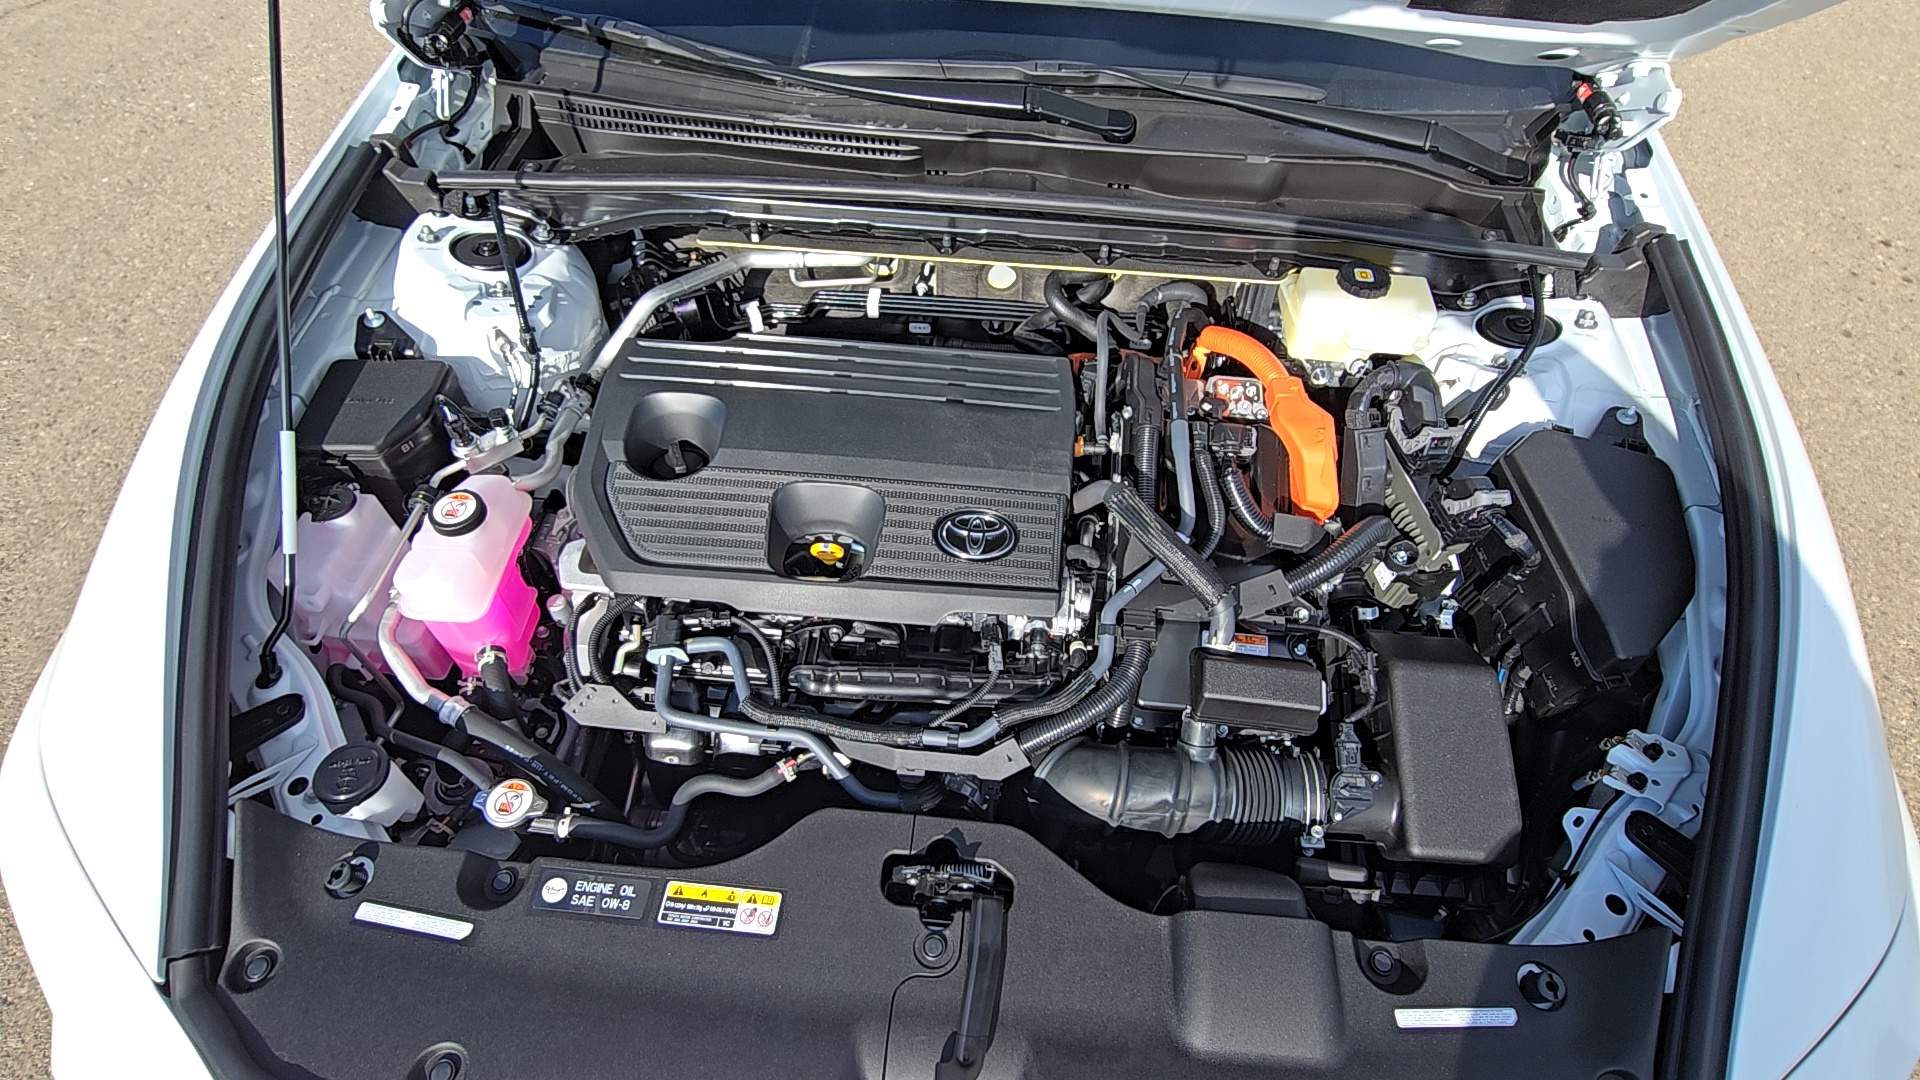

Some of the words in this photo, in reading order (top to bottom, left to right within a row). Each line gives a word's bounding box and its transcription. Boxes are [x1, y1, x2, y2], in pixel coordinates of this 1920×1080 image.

[401, 440, 415, 453] B1
[1569, 650, 1581, 667] M3
[574, 880, 615, 895] ENGINE
[619, 884, 636, 897] OIL
[570, 893, 596, 907] SAE
[601, 897, 631, 911] 0W-8
